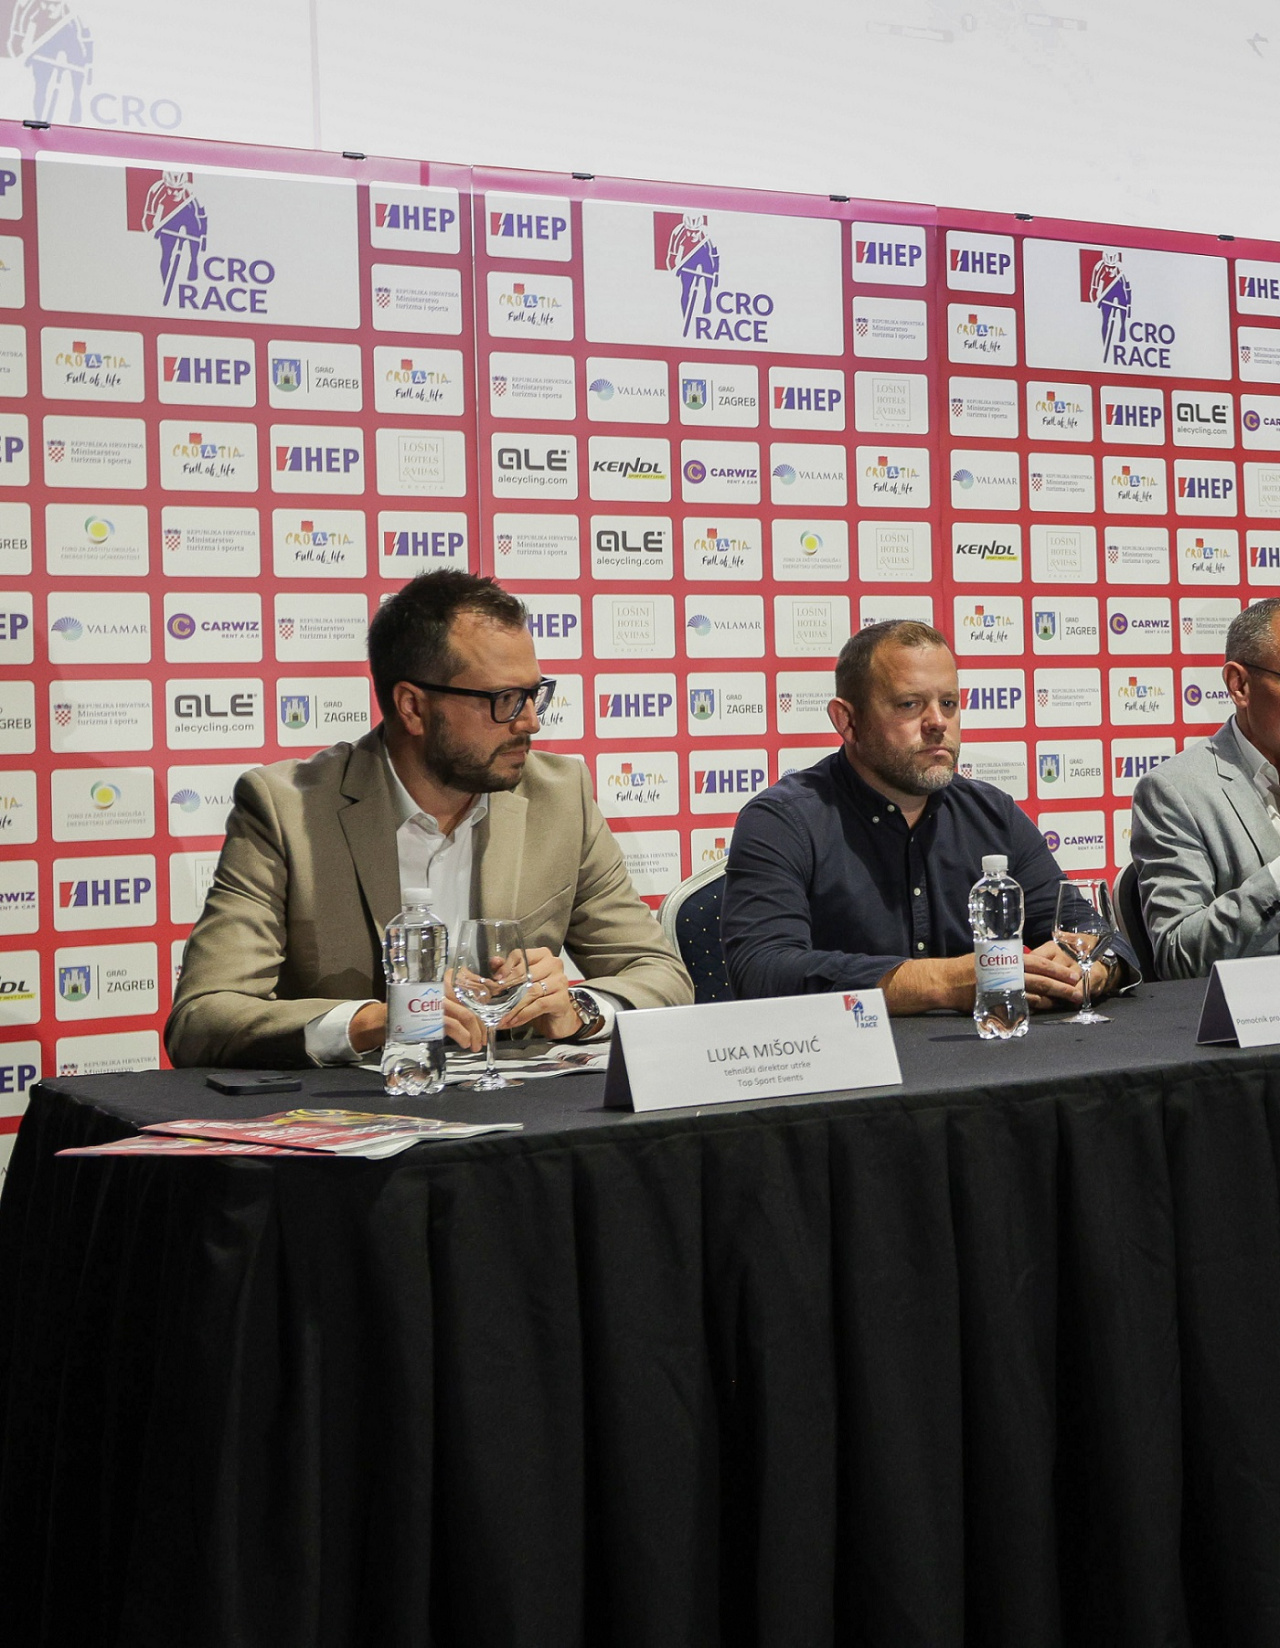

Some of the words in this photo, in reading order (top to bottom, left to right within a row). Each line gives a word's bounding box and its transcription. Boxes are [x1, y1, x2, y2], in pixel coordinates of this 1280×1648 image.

[90, 93, 182, 130] CRO
[403, 206, 454, 232] HEP
[517, 214, 566, 240] HEP
[879, 243, 922, 266] HEP
[972, 251, 1010, 275] HEP
[204, 257, 275, 284] CRO
[179, 284, 267, 314] RACE
[716, 292, 774, 316] CRO
[696, 317, 768, 342] RACE
[1130, 322, 1175, 344] CRO
[56, 353, 130, 368] CROATIA
[1114, 345, 1170, 368] RACE
[194, 358, 250, 385] HEP
[316, 378, 359, 389] ZAGREB
[618, 386, 666, 396] VALAMAR
[719, 396, 756, 406] ZAGREB
[798, 388, 841, 411] HEP
[1125, 405, 1162, 427] HEP
[1177, 426, 1227, 435] alecycling.com
[305, 447, 359, 472] HEP
[498, 474, 567, 486] alecycling.com
[710, 468, 757, 478] CARWIZ
[799, 471, 844, 480] VALAMAR
[976, 476, 1017, 484] VALAMAR
[1198, 478, 1232, 499] HEP
[286, 532, 353, 546] CROATIA
[412, 532, 464, 556] HEP
[694, 538, 751, 552] CROATIA
[597, 556, 663, 567] alecycling.com
[201, 622, 258, 631] CARWIZ
[964, 615, 1014, 627] CROATIA
[1132, 620, 1169, 628] CARWIZ
[87, 625, 147, 634] VALAMAR
[1066, 627, 1096, 635] ZAGREB
[625, 694, 672, 717] HEP
[982, 688, 1021, 709] HEP
[727, 704, 763, 714] ZAGREB
[324, 712, 367, 722] ZAGREB
[175, 722, 254, 733] alecycling.com
[1070, 768, 1101, 777] ZAGREB
[719, 769, 764, 793] HEP
[1064, 836, 1103, 845] CARWIZ
[92, 878, 151, 906] HEP
[979, 954, 1018, 967] Cetina
[108, 980, 154, 992] ZAGREB
[408, 999, 442, 1013] Ceti
[707, 1046, 749, 1062] LUKA
[753, 1036, 820, 1058] MIŠOVIĆ
[724, 1066, 755, 1076] tehnički
[758, 1064, 788, 1072] direktor
[790, 1061, 810, 1069] utrke
[754, 1077, 776, 1086] Sport
[778, 1075, 803, 1083] Events
